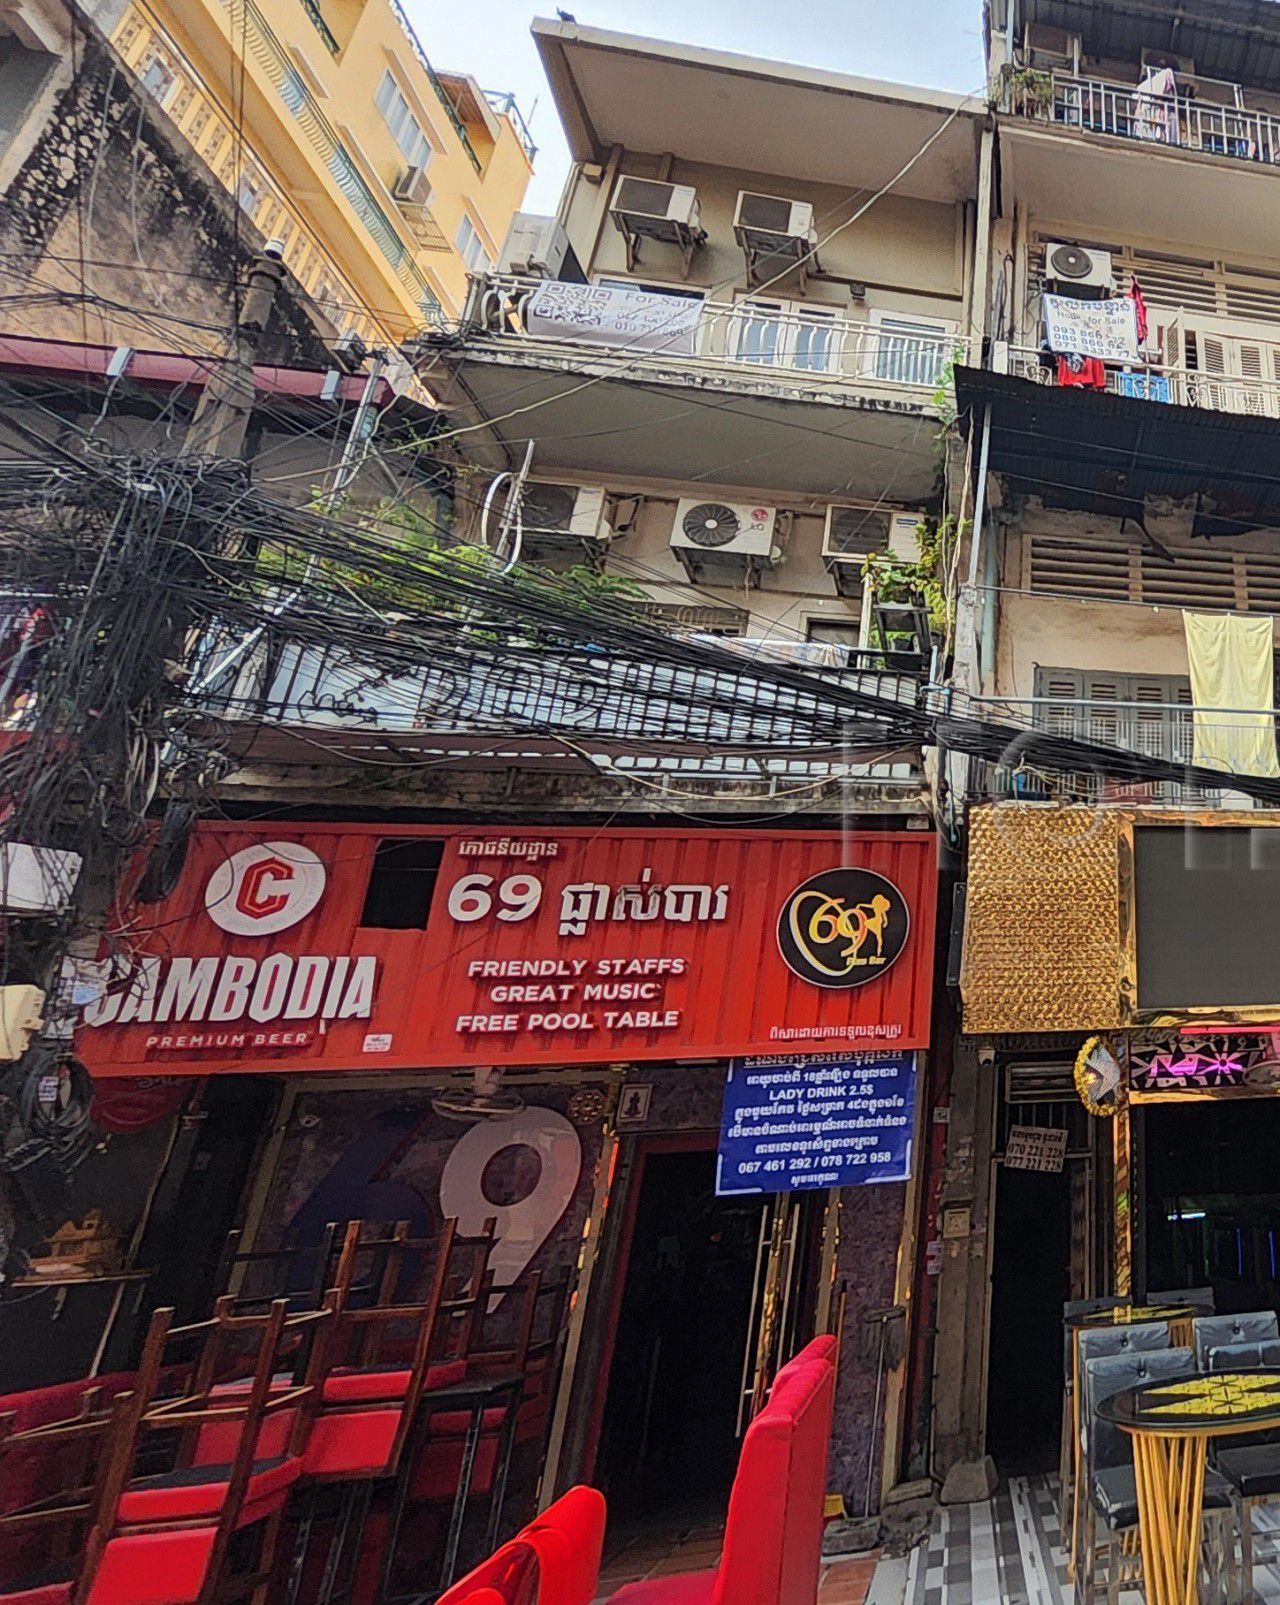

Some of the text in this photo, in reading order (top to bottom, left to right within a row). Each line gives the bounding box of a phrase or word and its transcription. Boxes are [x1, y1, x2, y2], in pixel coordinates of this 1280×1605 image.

[448, 874, 543, 922] 69
[468, 958, 686, 977] FRIENDLY STAFFS
[490, 983, 656, 1002] GREAT MUSIC
[456, 1010, 680, 1032] FREE POOL TABLE
[146, 1032, 308, 1049] PREMIUM BEER
[769, 1084, 874, 1101] LADY DRINK 2.5$
[738, 1161, 761, 1174] 067
[763, 1159, 785, 1172] 461
[789, 1157, 811, 1170] 292
[821, 1155, 843, 1167] 078
[846, 1152, 867, 1165] 722
[870, 1151, 891, 1164] 958
